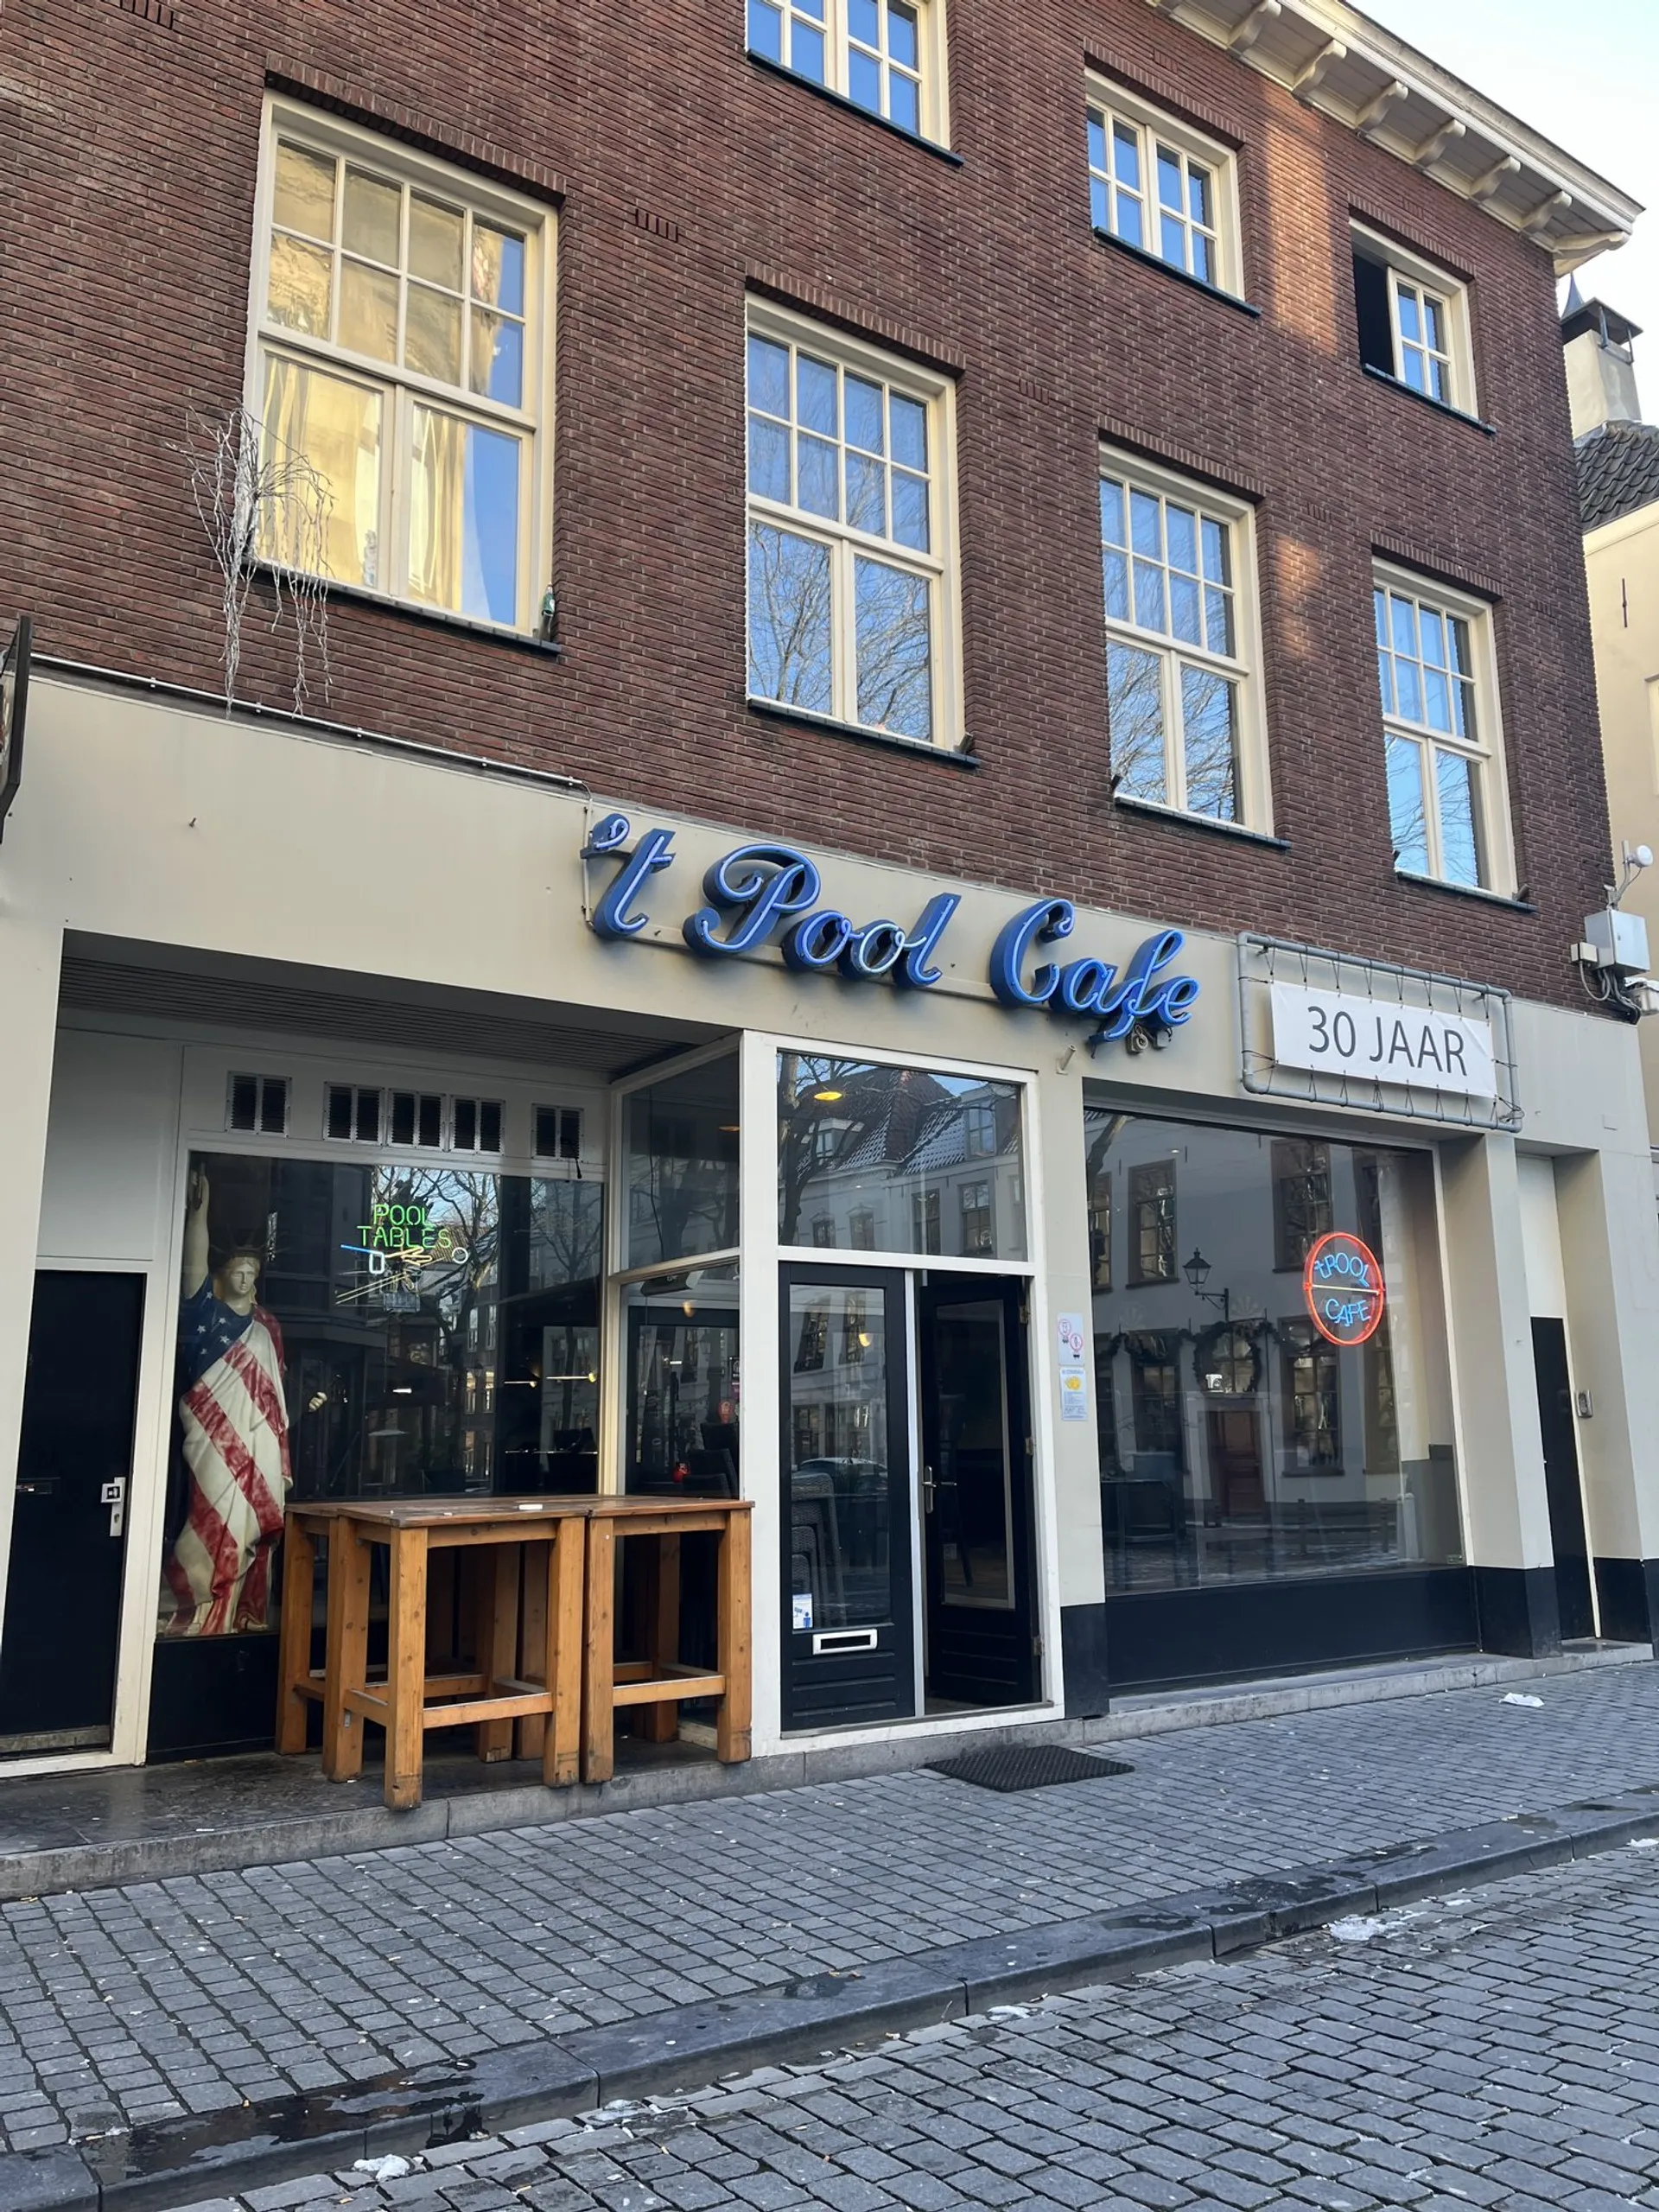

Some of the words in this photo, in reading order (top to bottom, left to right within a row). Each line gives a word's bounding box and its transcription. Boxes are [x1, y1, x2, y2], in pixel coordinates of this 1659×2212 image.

[683, 843, 962, 988] Pool
[989, 897, 1200, 1043] Cafe
[1307, 1006, 1356, 1058] 30
[1370, 1016, 1467, 1077] JAAR
[373, 1204, 436, 1227] POOL
[357, 1225, 452, 1249] TABLES
[1325, 1298, 1371, 1327] CAFE
